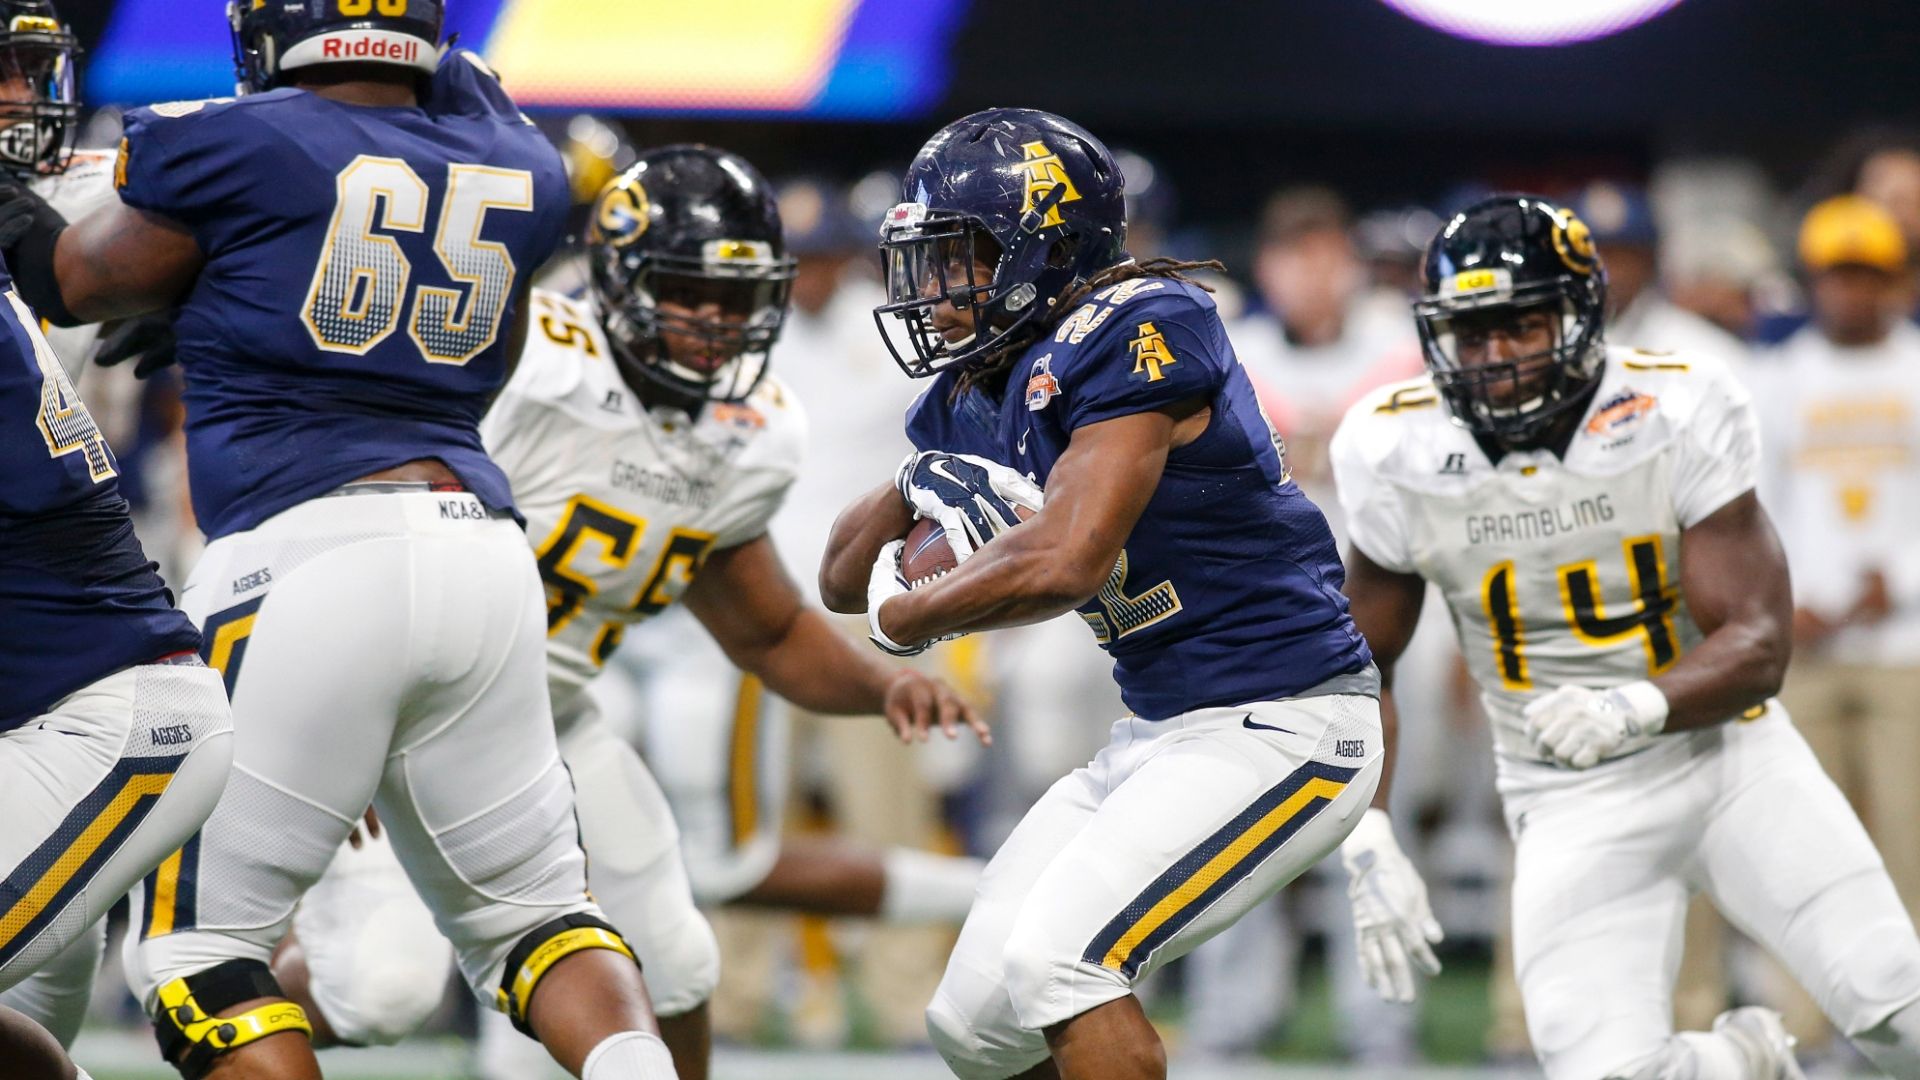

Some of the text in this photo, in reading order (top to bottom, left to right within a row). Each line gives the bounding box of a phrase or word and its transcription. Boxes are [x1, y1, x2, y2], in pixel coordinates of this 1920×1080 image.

[322, 37, 419, 62] Riddell
[299, 153, 534, 366] 65
[1054, 278, 1166, 345] 22
[438, 500, 492, 520] NCA&
[1466, 494, 1615, 545] GRAMBLING
[233, 566, 272, 595] AGGIES
[1079, 548, 1183, 644] 2
[1480, 533, 1682, 692] 14
[150, 723, 193, 746] AGGIES
[1334, 739, 1365, 758] AGGIES
